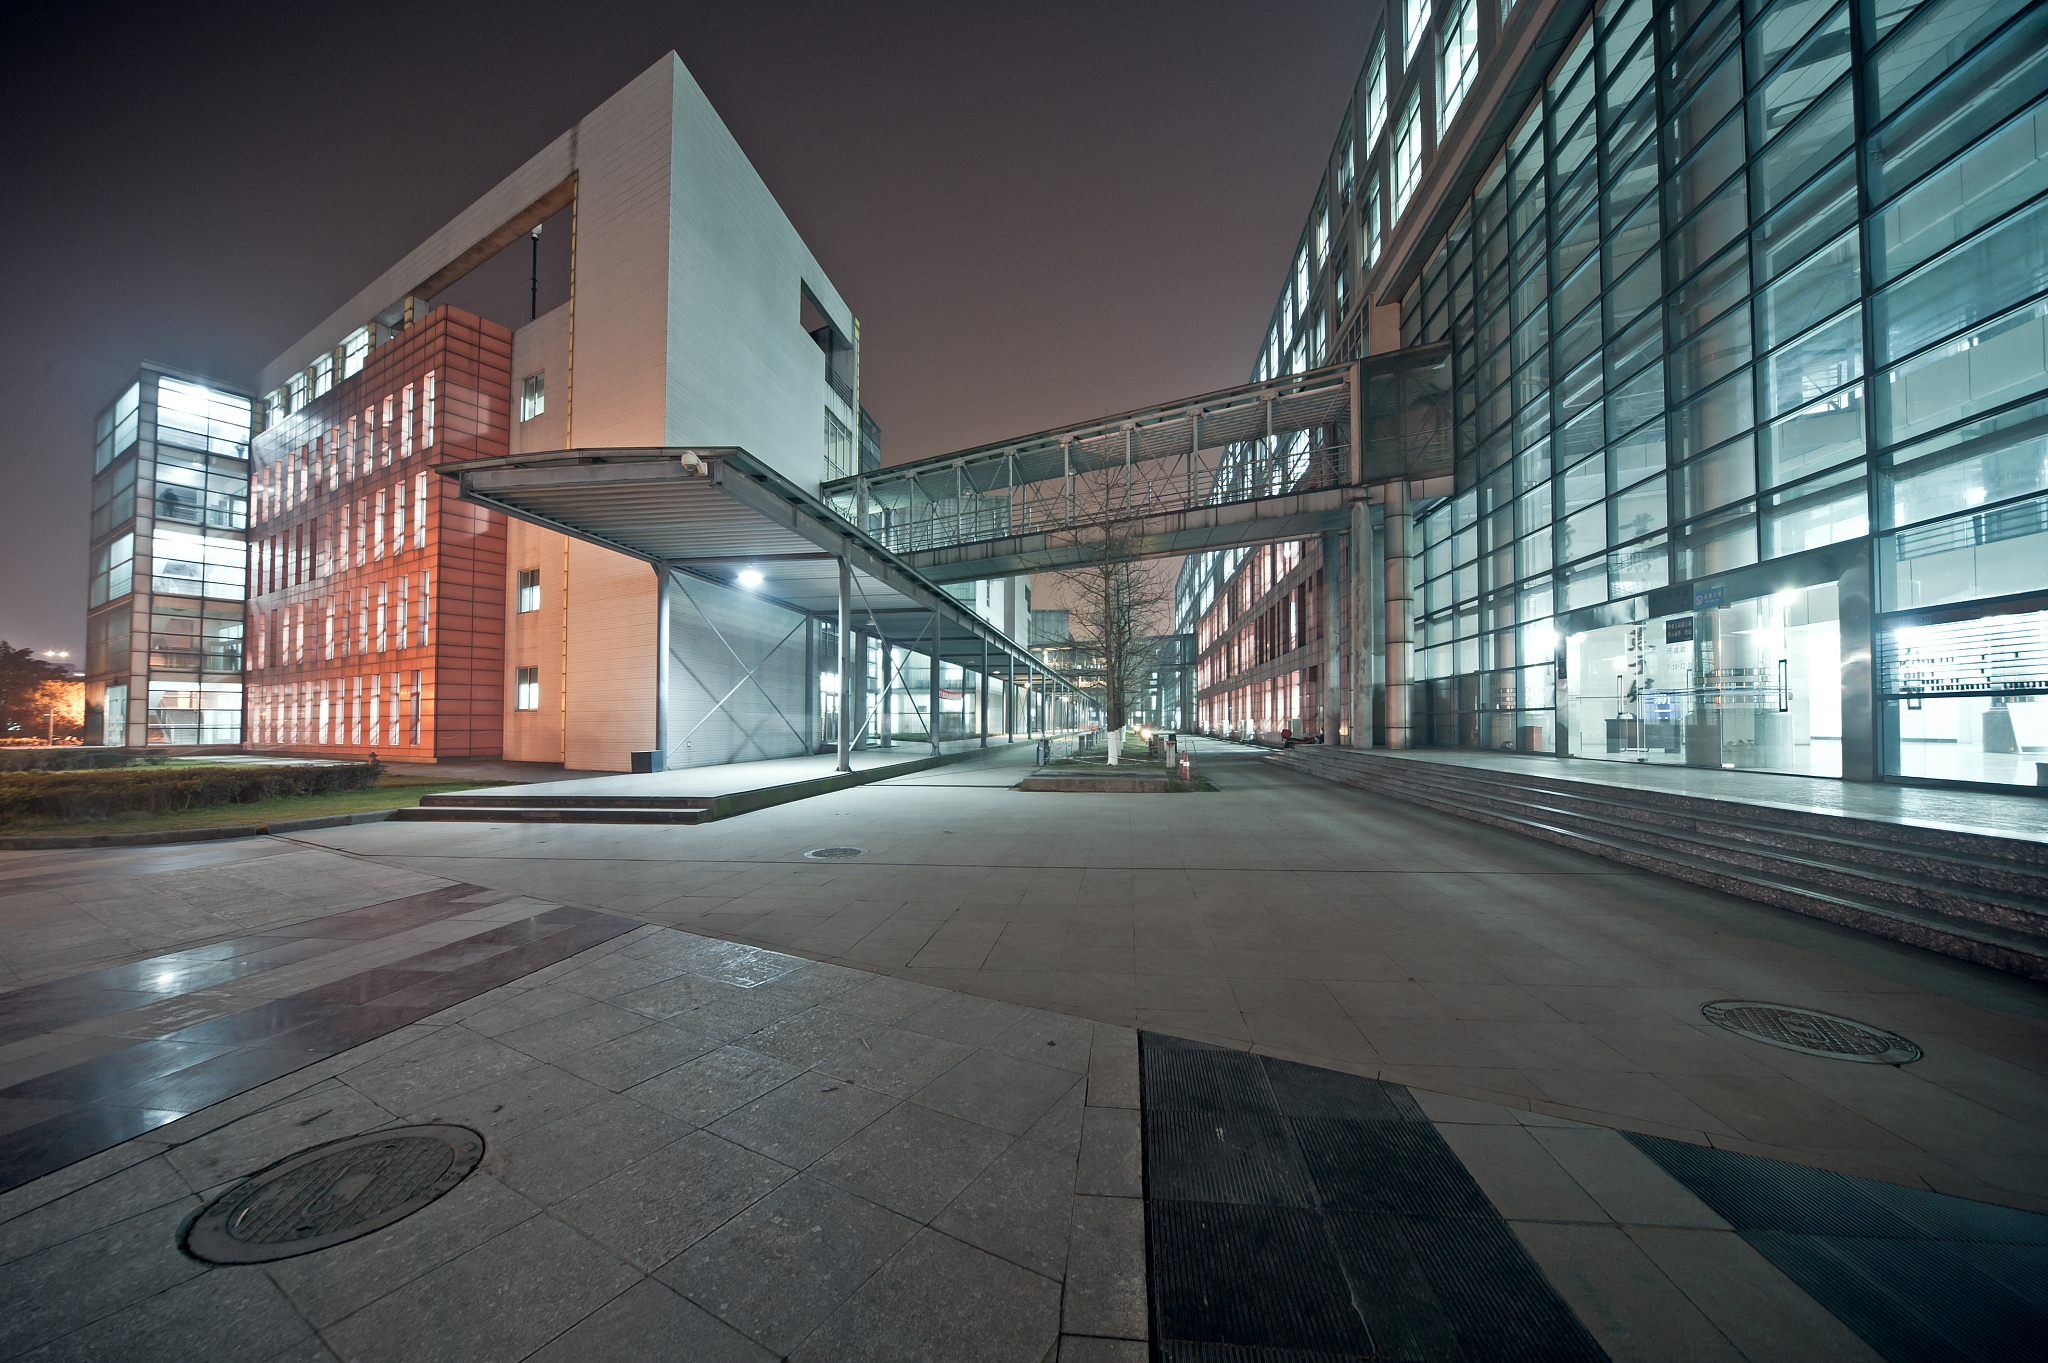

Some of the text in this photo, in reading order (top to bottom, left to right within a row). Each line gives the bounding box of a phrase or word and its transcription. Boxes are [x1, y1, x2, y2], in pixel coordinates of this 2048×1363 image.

[1920, 616, 1931, 624] 30
[1667, 645, 1689, 654] 开放时
